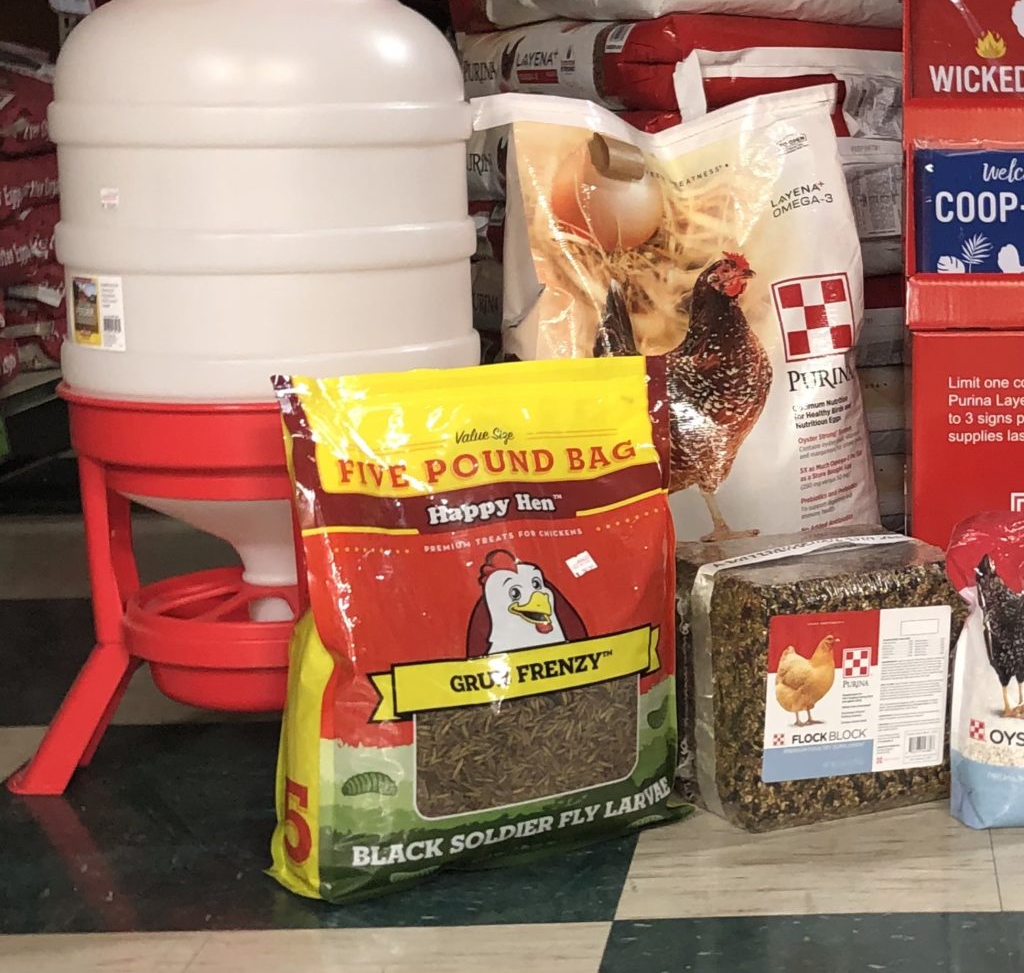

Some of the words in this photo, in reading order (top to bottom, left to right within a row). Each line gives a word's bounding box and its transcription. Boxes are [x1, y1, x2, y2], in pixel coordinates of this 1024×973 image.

[773, 193, 833, 218] OMEGA-3
[787, 367, 854, 392] PURIN
[948, 376, 981, 389] Limit
[985, 379, 1009, 389] one
[948, 394, 992, 407] Purina
[948, 412, 961, 425] to
[965, 412, 973, 425] 3
[978, 412, 1012, 428] signs
[455, 428, 489, 445] Value
[489, 427, 515, 446] Size
[948, 429, 1003, 446] supplies
[339, 458, 409, 489] FIVE
[425, 448, 555, 484] POUND
[568, 439, 637, 474] BAG
[427, 496, 509, 527] Happy
[424, 539, 471, 553] PREMIUM
[475, 532, 514, 546] TREATS
[517, 529, 536, 539] FOR
[538, 527, 583, 538] CHICKENS
[842, 680, 870, 689] PURINA
[792, 732, 827, 744] FLOCK
[829, 728, 867, 741] BLOCK
[284, 776, 314, 867] 5
[352, 837, 444, 868] BLACK
[450, 816, 553, 855] SOLDIER
[558, 803, 600, 829] FLY
[603, 776, 671, 820] LARVAE
